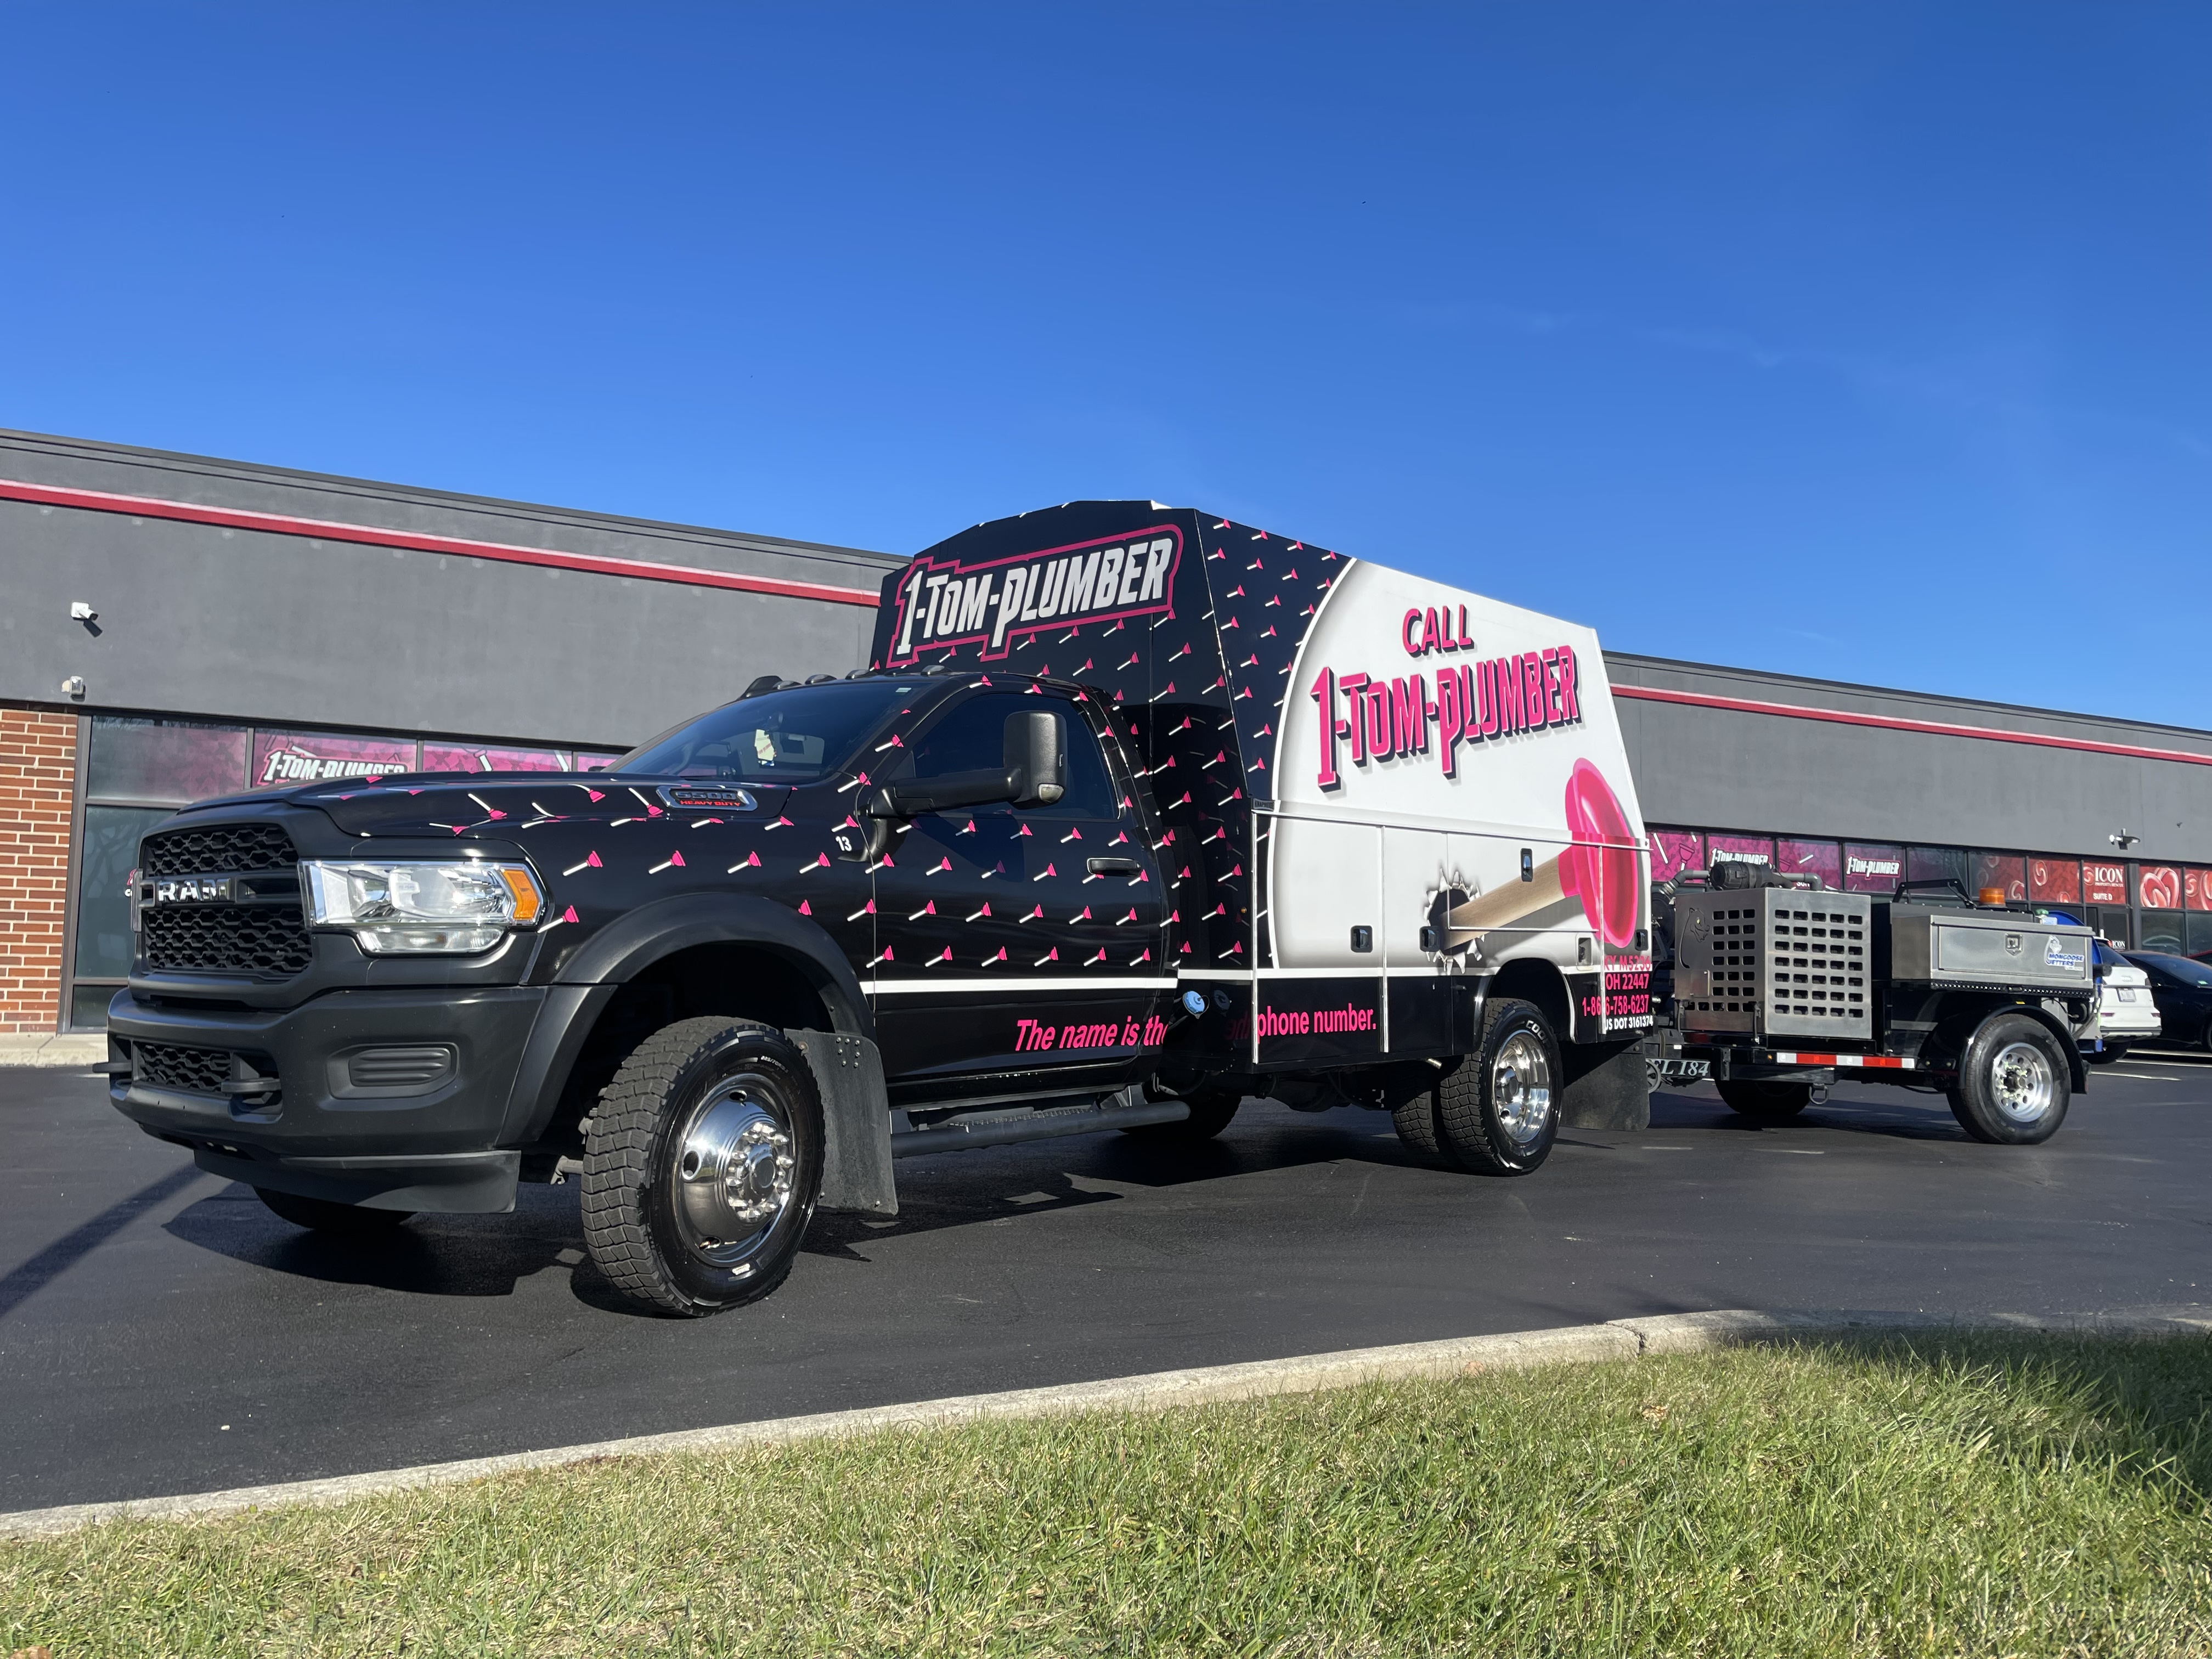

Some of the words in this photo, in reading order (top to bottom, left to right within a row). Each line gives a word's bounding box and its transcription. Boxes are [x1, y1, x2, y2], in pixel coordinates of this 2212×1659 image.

[896, 538, 1173, 655] 1-TOM-PLUMBER
[1402, 604, 1475, 656] CALL
[1310, 645, 1582, 793] 1-TOM-PLUMBER
[675, 791, 737, 800] 5500
[835, 836, 853, 852] 13
[1847, 856, 1900, 877] 1-TOM-PLUMBER
[2095, 867, 2124, 883] ICON
[158, 878, 231, 902] RAM
[2092, 892, 2108, 900] SUITE
[1605, 973, 1621, 990] OH
[1622, 973, 1650, 990] 22447
[1015, 1019, 1056, 1052] The
[1059, 1024, 1119, 1049] name
[1120, 1015, 1140, 1046] is
[1257, 1005, 1310, 1043] phone
[1313, 1003, 1376, 1033] number.
[1614, 1017, 1628, 1030] DOT
[1628, 1015, 1654, 1029] 3161374
[1678, 1060, 1710, 1076] 184
